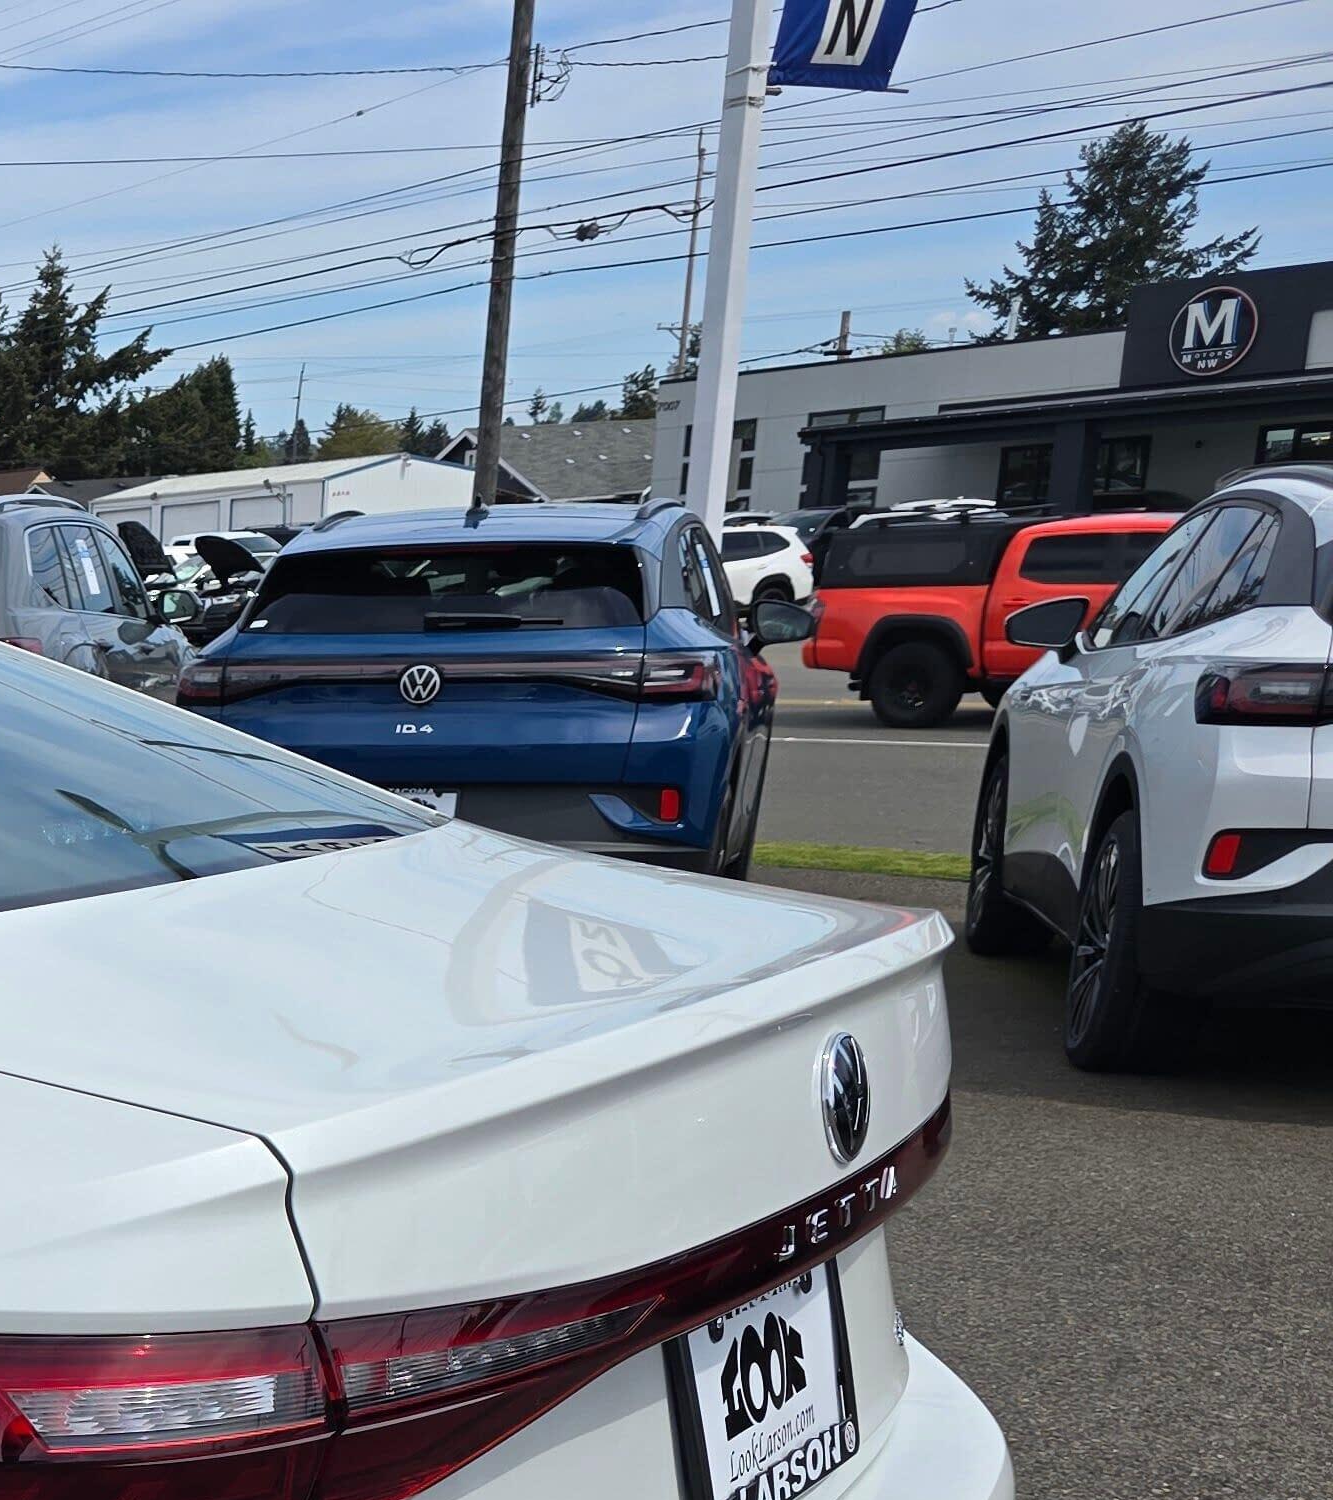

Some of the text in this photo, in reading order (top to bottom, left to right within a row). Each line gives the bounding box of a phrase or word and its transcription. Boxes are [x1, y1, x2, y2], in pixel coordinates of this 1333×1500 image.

[1182, 297, 1241, 349] M
[1182, 350, 1233, 363] MOTORS
[1197, 359, 1218, 369] NW
[773, 1165, 898, 1263] JETTA
[729, 1403, 815, 1483] LookLarson.com
